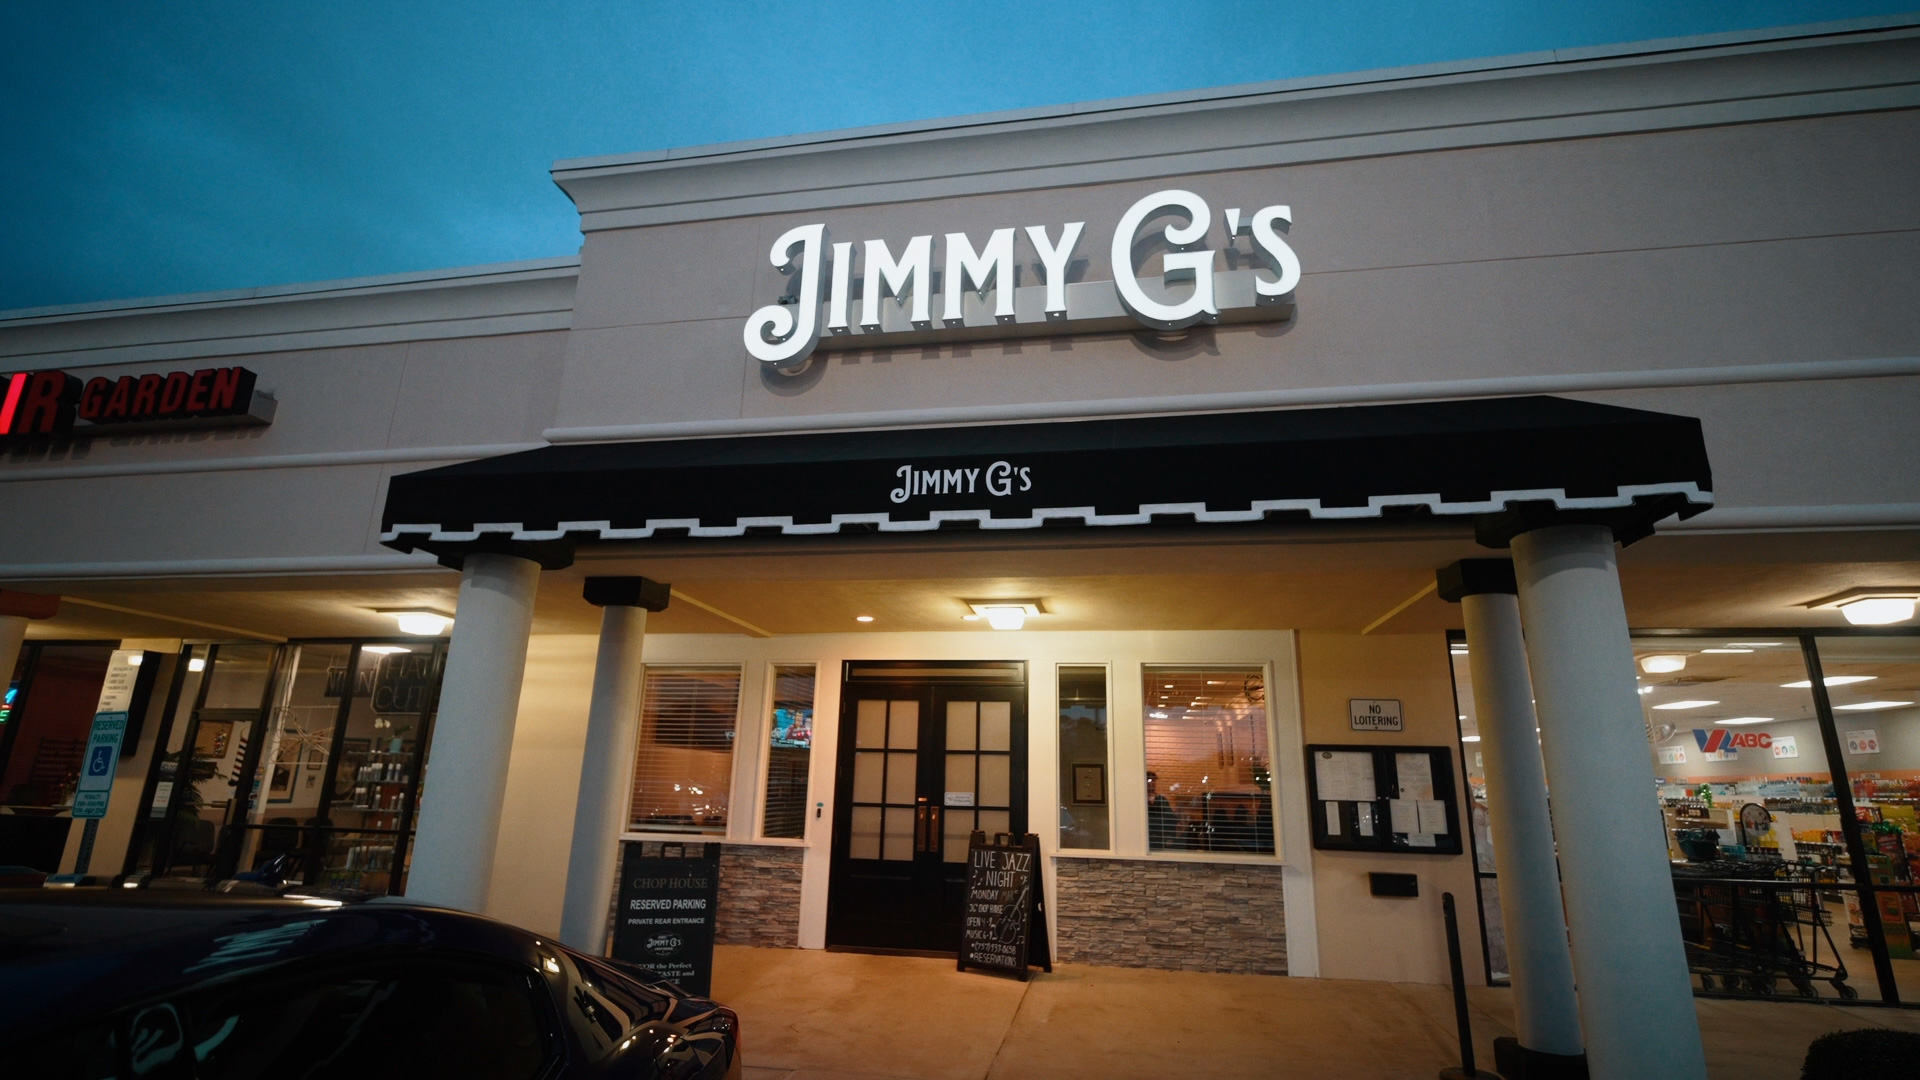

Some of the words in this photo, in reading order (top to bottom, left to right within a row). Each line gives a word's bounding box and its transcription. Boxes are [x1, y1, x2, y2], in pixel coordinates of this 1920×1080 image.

[743, 221, 1087, 364] JIMMY
[1111, 189, 1301, 328] G'S
[79, 366, 243, 421] GARDEN
[889, 464, 980, 504] JIMMY
[985, 460, 1032, 497] G'S
[1368, 704, 1382, 715] NO
[94, 720, 125, 730] RESERVED
[1354, 715, 1399, 726] LOITERING
[92, 733, 119, 744] PARKING
[1729, 732, 1773, 749] ABC
[974, 851, 996, 868] LIVE
[1002, 852, 1032, 872] JAZZ
[633, 877, 668, 889] CHOP
[669, 877, 709, 889] HOUSE
[986, 871, 1015, 887] NIGHT
[970, 889, 999, 900] MONDAY
[630, 899, 672, 910] RESERVED
[672, 899, 707, 910] PARKING
[672, 917, 705, 925] ENTRANCE
[974, 953, 1017, 966] RESERVATIONS
